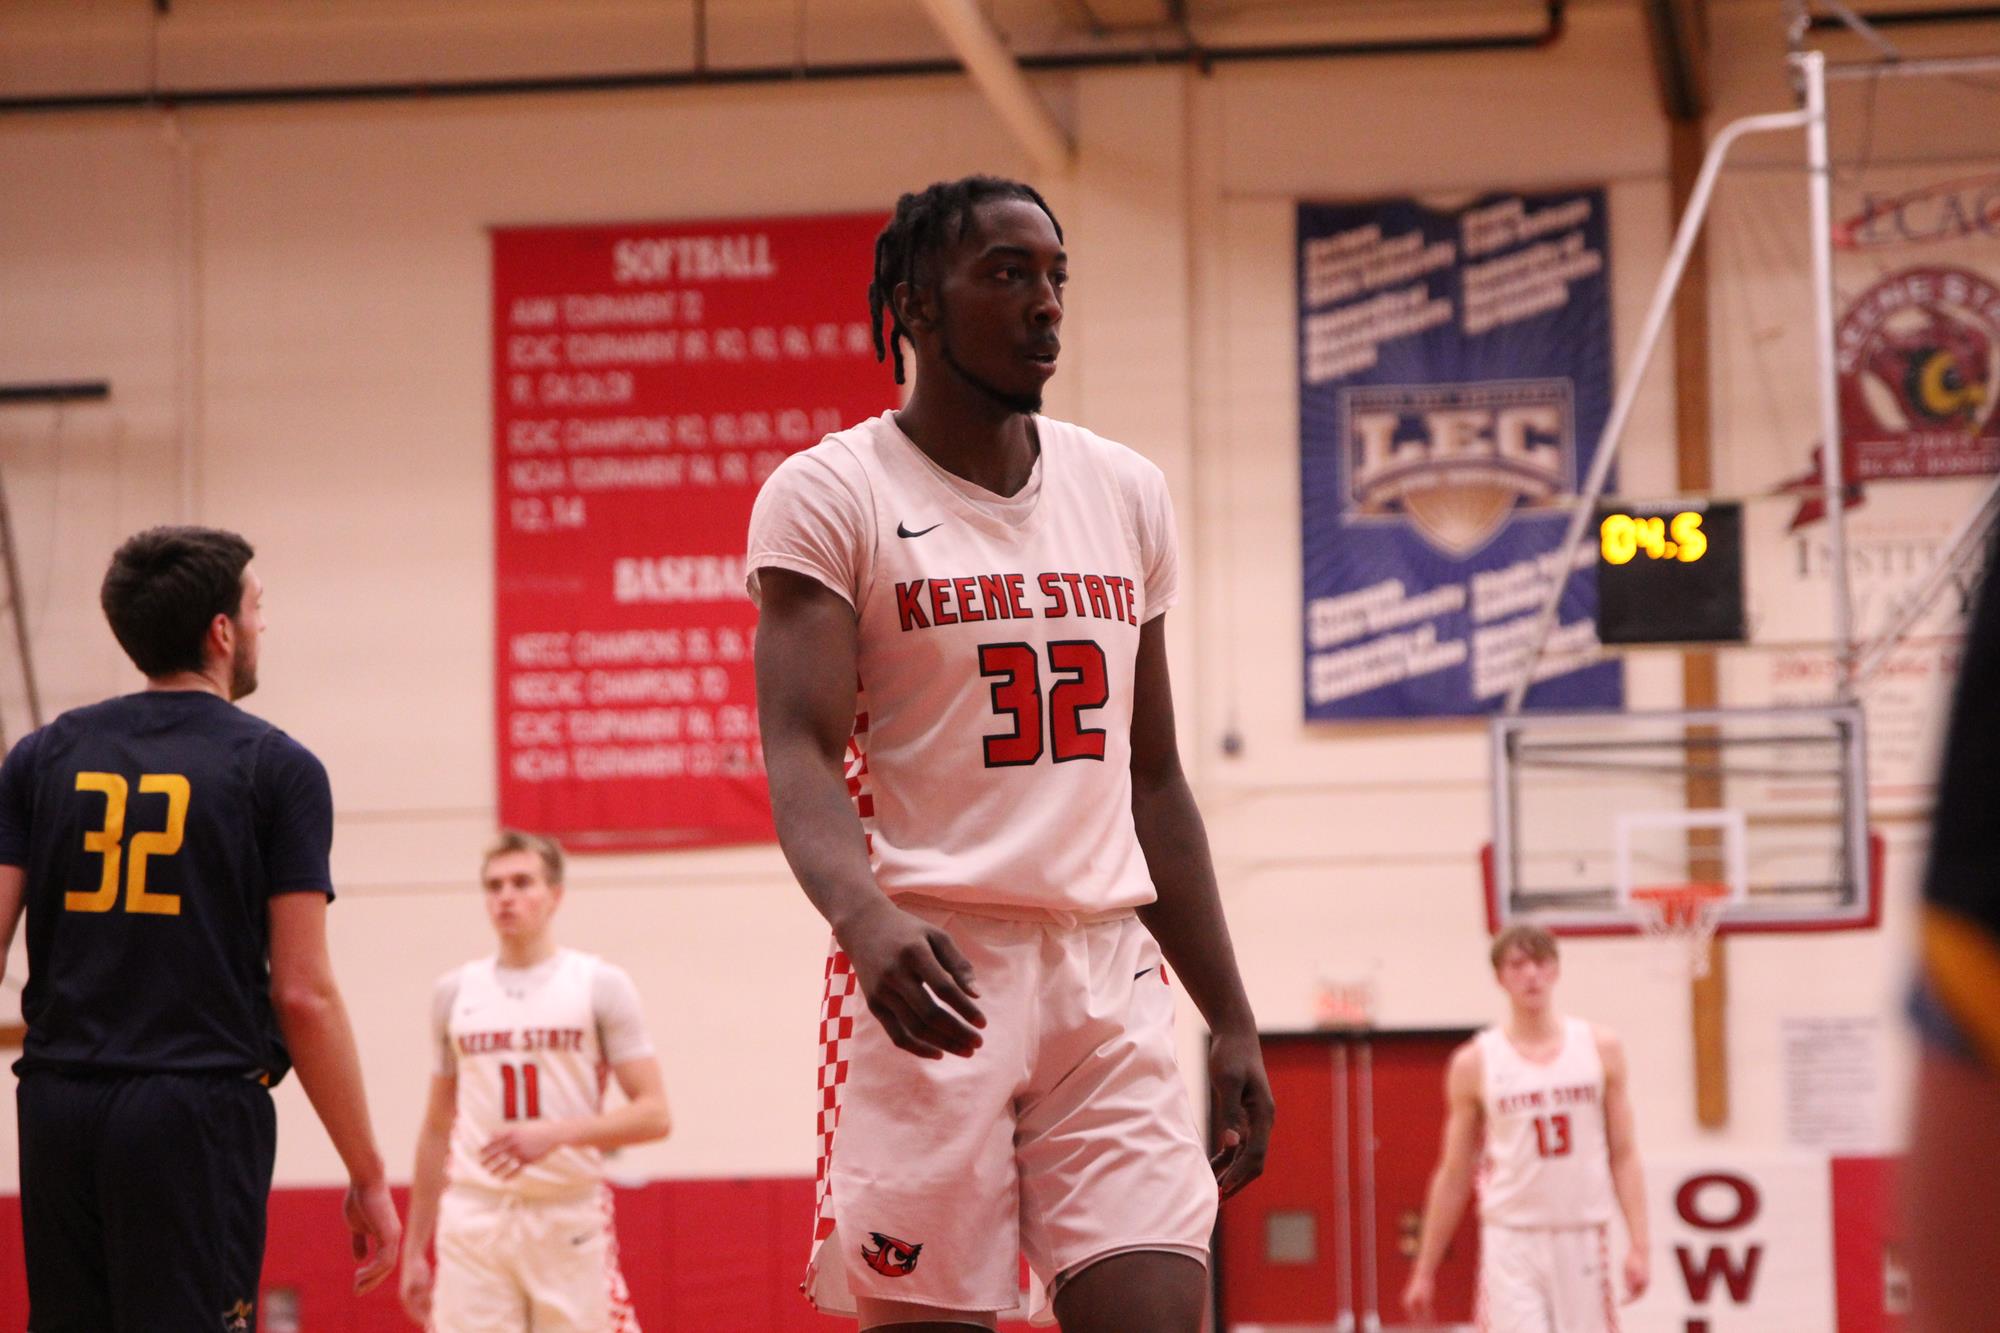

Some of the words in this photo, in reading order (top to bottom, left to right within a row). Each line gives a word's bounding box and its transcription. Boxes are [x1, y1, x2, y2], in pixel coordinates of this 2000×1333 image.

[613, 235, 774, 282] SOFTBALL
[1352, 404, 1563, 481] LEC
[895, 574, 1033, 632] KEENE
[1037, 572, 1137, 627] STATE
[977, 639, 1109, 768] 32
[64, 771, 190, 915] 32
[457, 1031, 514, 1055] KEENE
[523, 1027, 583, 1051] STATE
[501, 1062, 540, 1122] 11
[1533, 1114, 1571, 1158] 13
